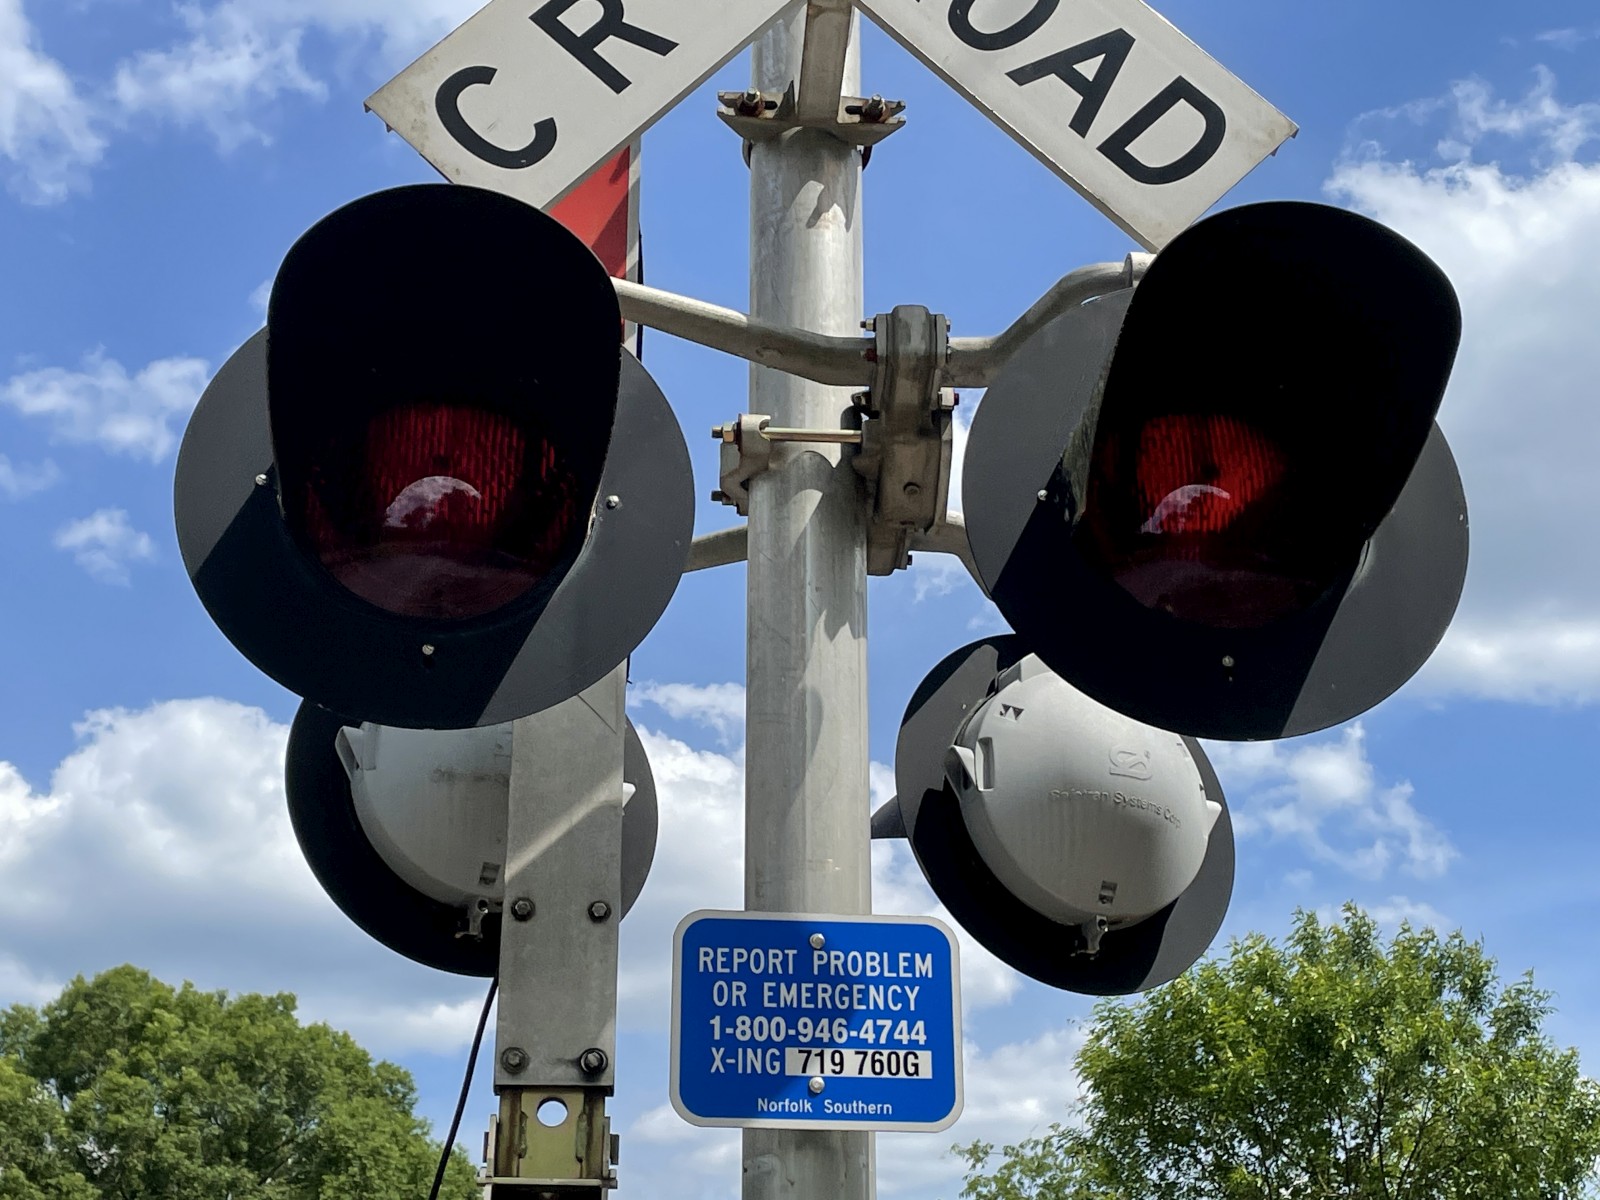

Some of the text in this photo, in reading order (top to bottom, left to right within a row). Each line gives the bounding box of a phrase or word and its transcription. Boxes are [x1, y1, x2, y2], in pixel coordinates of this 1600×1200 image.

[914, 0, 1227, 186] AD
[1113, 790, 1162, 815] Systems
[698, 947, 933, 978] REPORT PROBLEM
[713, 980, 920, 1011] OR EMERGENCY
[709, 1015, 927, 1045] 1-800-946-4744
[710, 1047, 920, 1077] X-ING 719 760G
[757, 1098, 893, 1115] Norfolk Southern
